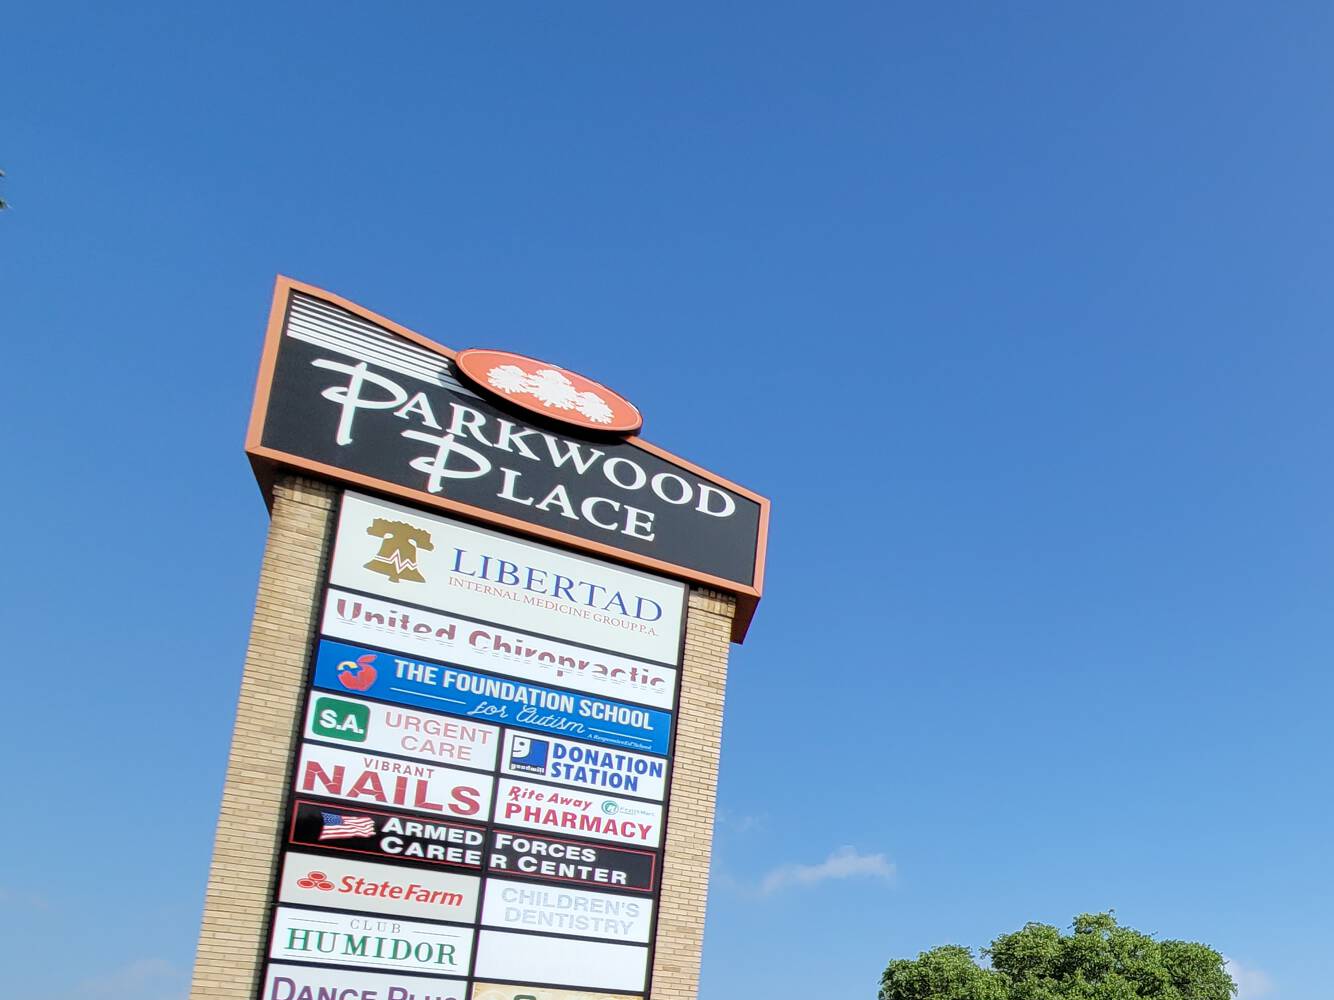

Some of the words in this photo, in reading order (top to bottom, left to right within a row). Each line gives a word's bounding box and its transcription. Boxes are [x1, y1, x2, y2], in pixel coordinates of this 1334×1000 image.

[311, 358, 736, 518] PARKWOOD
[401, 430, 655, 541] PLACE
[449, 576, 520, 602] INTERNAL
[522, 595, 591, 619] MEDICINE
[450, 548, 663, 622] LIBERTAD
[337, 599, 456, 643] United
[468, 630, 666, 690] Chiropractic
[394, 659, 439, 686] THE
[442, 671, 574, 714] FOUNDATION
[578, 699, 654, 731] SCHOOL
[319, 708, 364, 734] S.A.
[385, 711, 493, 745] URGENT
[466, 701, 509, 719] for
[516, 703, 586, 734] Autism
[401, 735, 473, 761] CARE
[553, 742, 664, 779] DONATION
[363, 757, 435, 779] VIBRANT
[551, 761, 639, 792] STATION
[302, 760, 481, 816] NAILS
[508, 786, 545, 802] Rite
[547, 793, 593, 811] Away
[381, 817, 484, 846] ARMED
[494, 832, 597, 862] FORCES
[504, 802, 653, 841] PHARMACY
[517, 856, 628, 885] CENTER
[350, 918, 401, 934] CLUB
[503, 906, 634, 936] DENTISTRY
[284, 927, 457, 966] HUMIDOR
